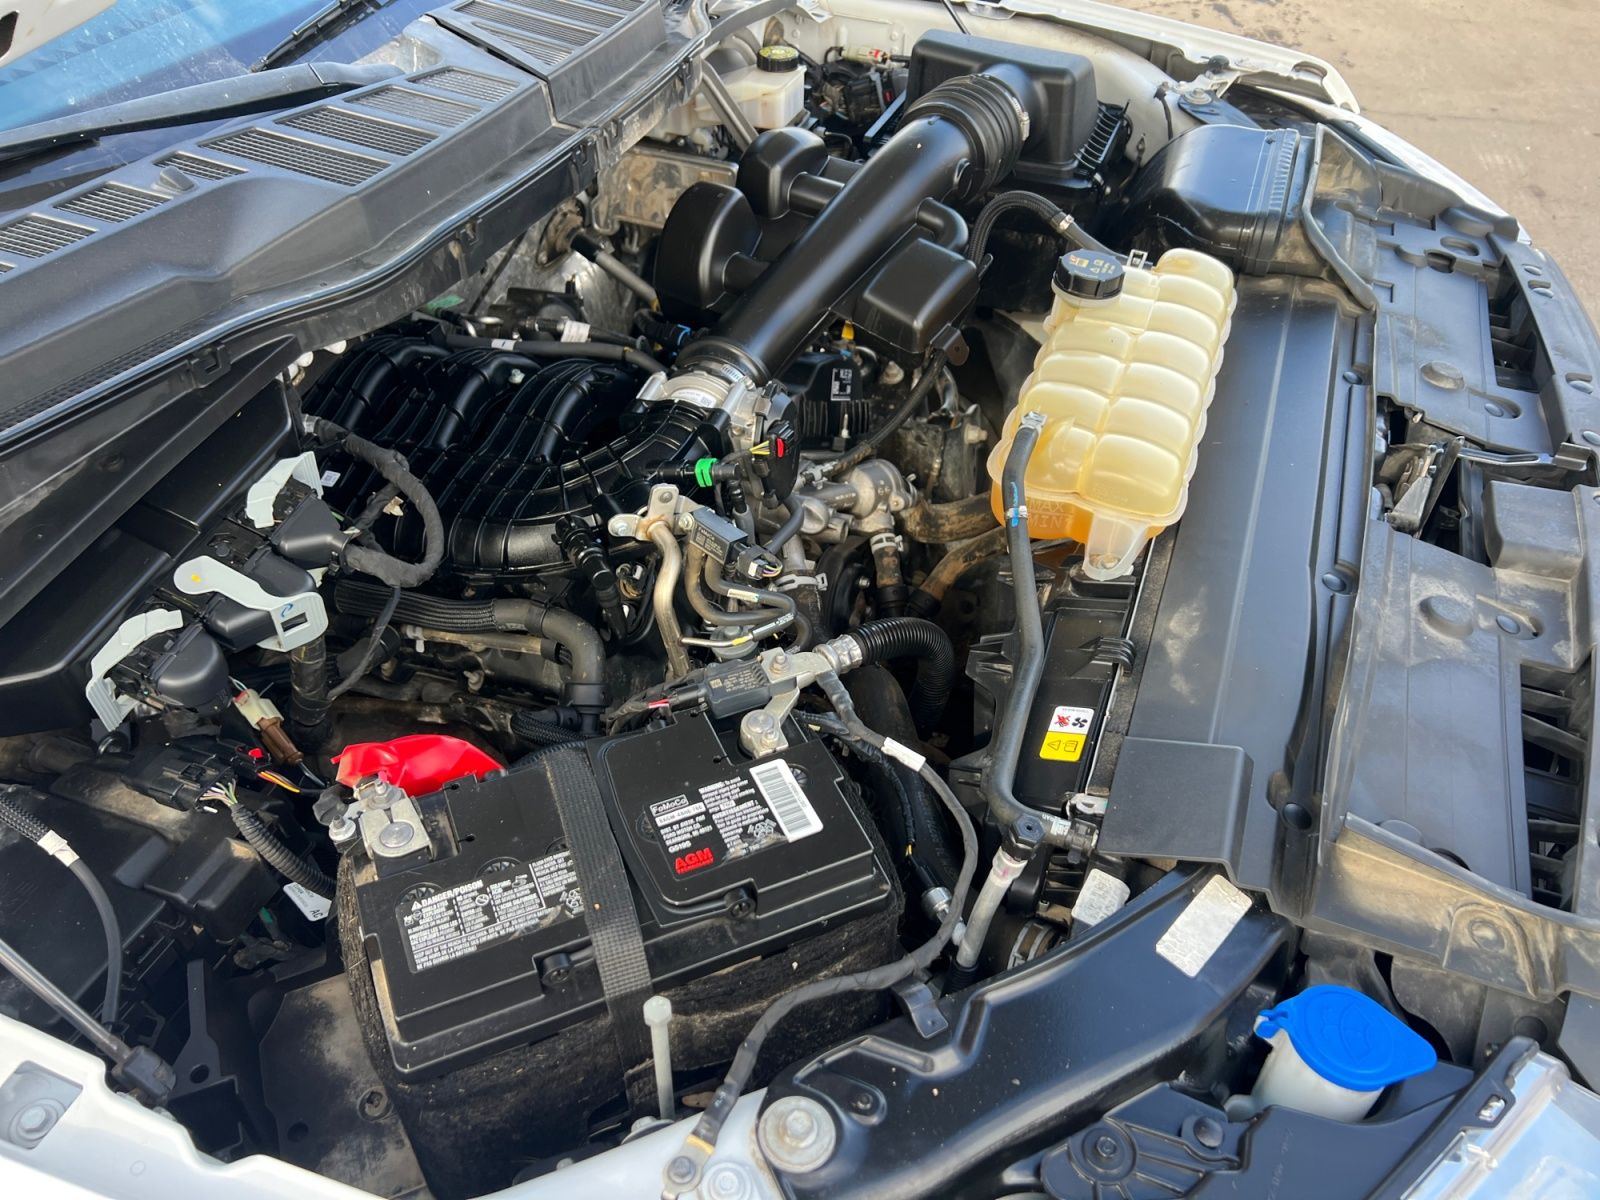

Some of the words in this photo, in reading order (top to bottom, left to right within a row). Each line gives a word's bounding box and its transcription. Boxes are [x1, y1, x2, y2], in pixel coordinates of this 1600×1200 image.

[1030, 500, 1064, 513] MAX
[1028, 514, 1061, 529] MIN
[652, 798, 687, 814] FoMoCo
[675, 848, 713, 869] AGM
[421, 879, 484, 907] DANGER/POISON
